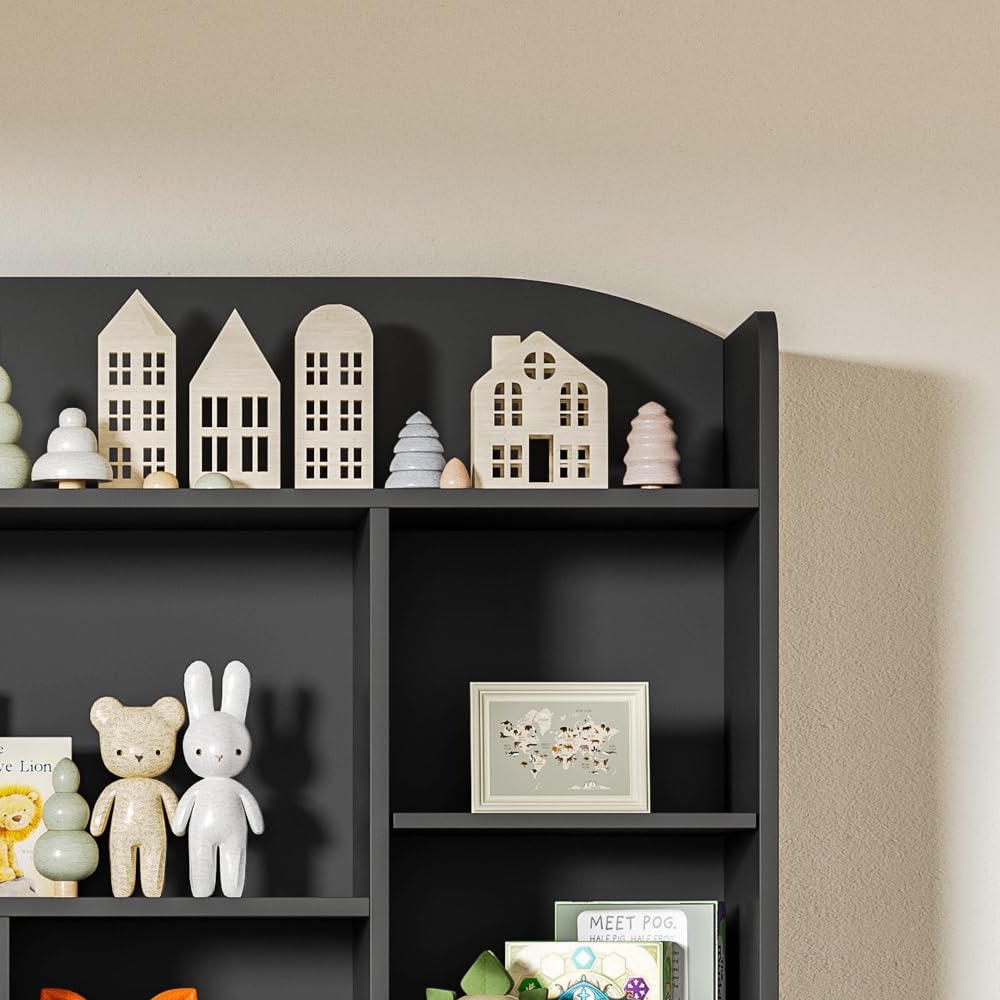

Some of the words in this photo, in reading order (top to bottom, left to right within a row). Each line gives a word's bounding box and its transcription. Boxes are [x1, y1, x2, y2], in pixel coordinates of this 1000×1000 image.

[19, 760, 52, 773] Lion
[589, 914, 636, 931] MEET
[643, 914, 677, 931] POG.
